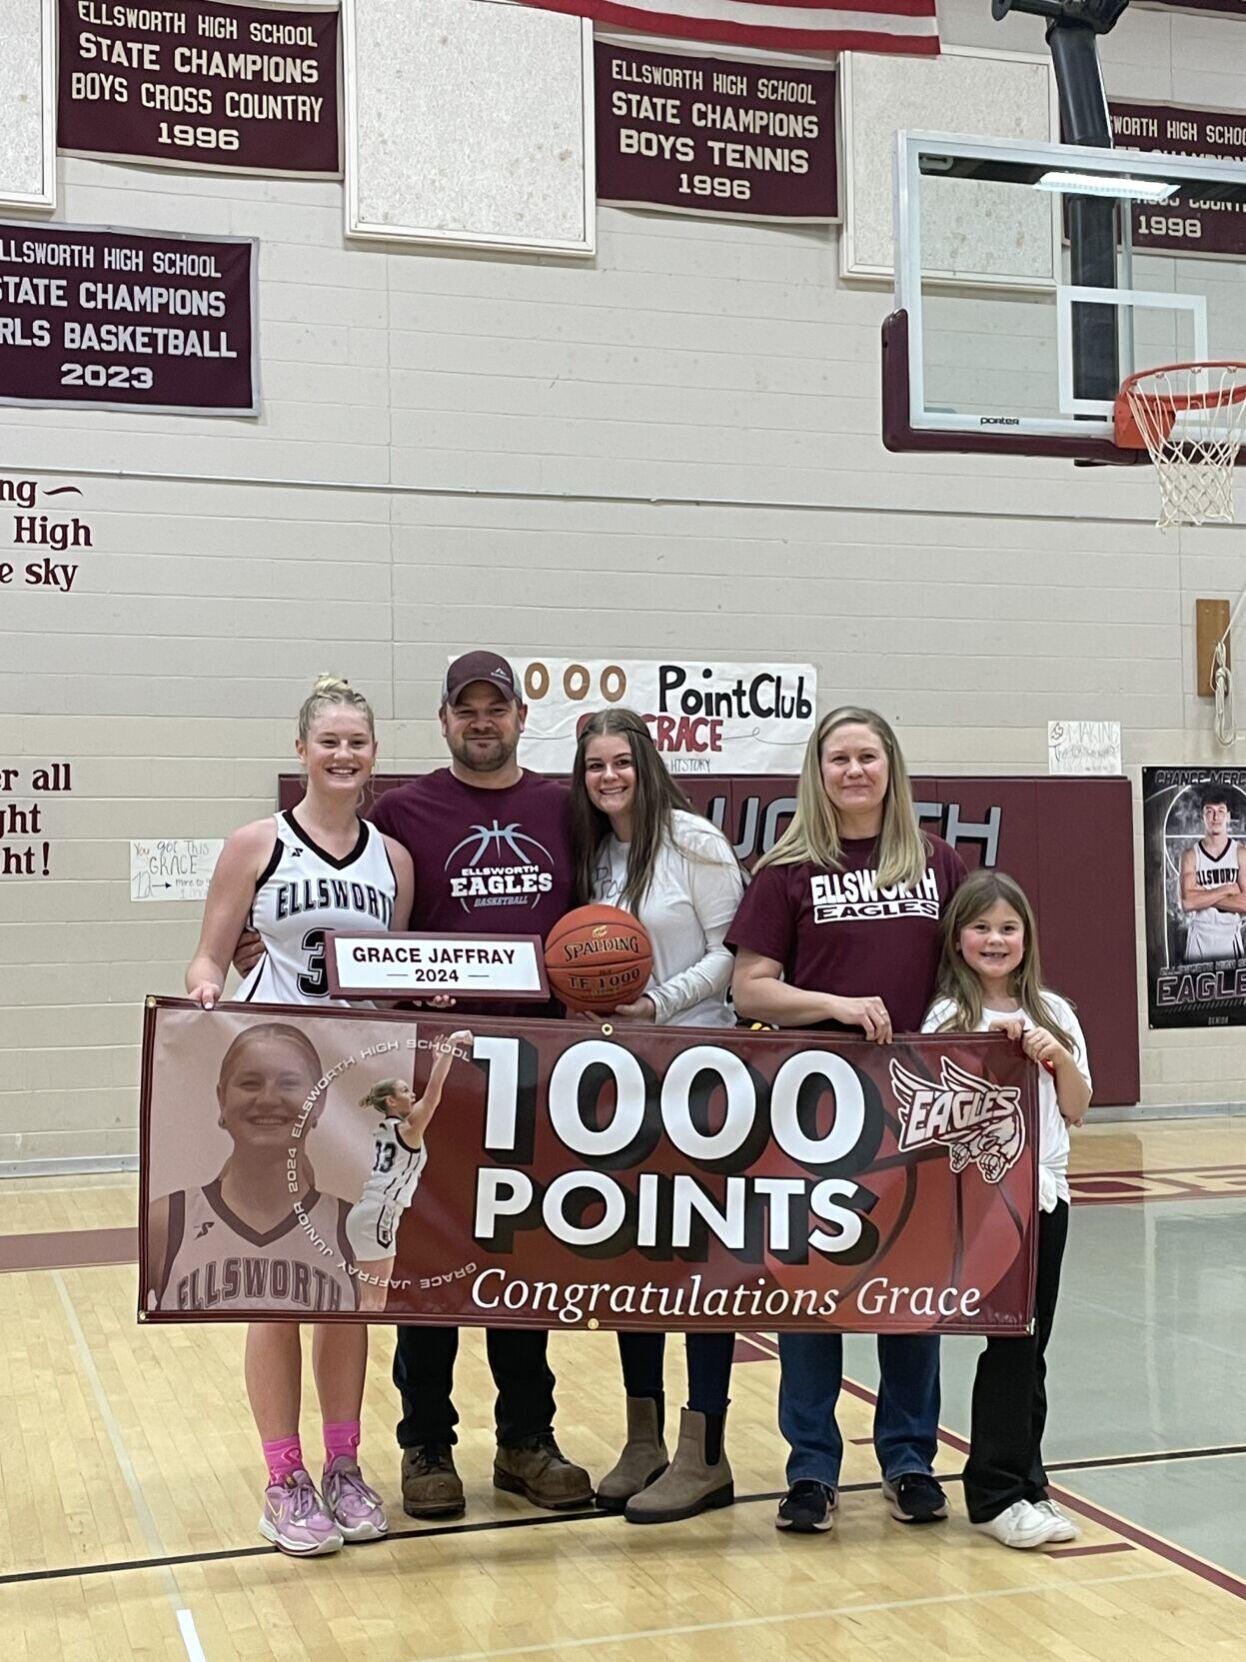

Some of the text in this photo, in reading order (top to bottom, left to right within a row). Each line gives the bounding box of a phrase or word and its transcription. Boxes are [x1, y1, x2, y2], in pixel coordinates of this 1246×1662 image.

[78, 1, 318, 48] ELLSWORTH HIGH SCHOOL
[79, 32, 319, 84] STATE CHAMPIONS
[71, 72, 324, 123] BOYS CROSS COUNTRY
[611, 59, 817, 105] ELLSWORTH HIGH SCHOOL
[612, 91, 819, 139] STATE CHAMPIONS
[1109, 115, 1158, 138] WORTH
[1167, 120, 1198, 142] HIGH
[158, 122, 240, 151] 1996
[620, 128, 809, 174] BOYS TENNIS
[679, 173, 751, 200] 1996
[1138, 214, 1202, 239] 1998
[104, 247, 144, 272] HIGH
[152, 252, 222, 278] SCHOOL
[0, 276, 226, 318] TATE CHAMPIONS
[64, 322, 238, 358] BASKETBALL
[61, 363, 153, 390] 2023
[13, 515, 93, 551] High
[25, 557, 79, 592] sky
[658, 664, 748, 718] Point
[748, 672, 813, 720] Club
[0, 763, 72, 792] r all
[670, 757, 712, 774] HISTORY
[134, 842, 150, 857] You
[149, 854, 198, 876] GRACE
[450, 872, 553, 898] EAGLES
[461, 865, 539, 876] ELLSWORTH
[474, 896, 529, 907] BASKETBALL
[816, 901, 938, 921] EAGLES
[352, 946, 515, 965] GRACE JAFFRAY
[563, 936, 640, 962] SPALDING
[415, 969, 459, 982] 2024
[598, 968, 640, 988] 1000
[473, 1036, 866, 1164] 1000
[904, 1088, 1018, 1146] EAGLES
[287, 1039, 477, 1290] GRACE JAFFRAY JUNIOR 2024 ELLSWORTH HIGH SCHOOL
[474, 1167, 863, 1253] POINTS
[176, 1256, 342, 1311] ELLSWORTH
[471, 1267, 981, 1323] Congratulations Grace
